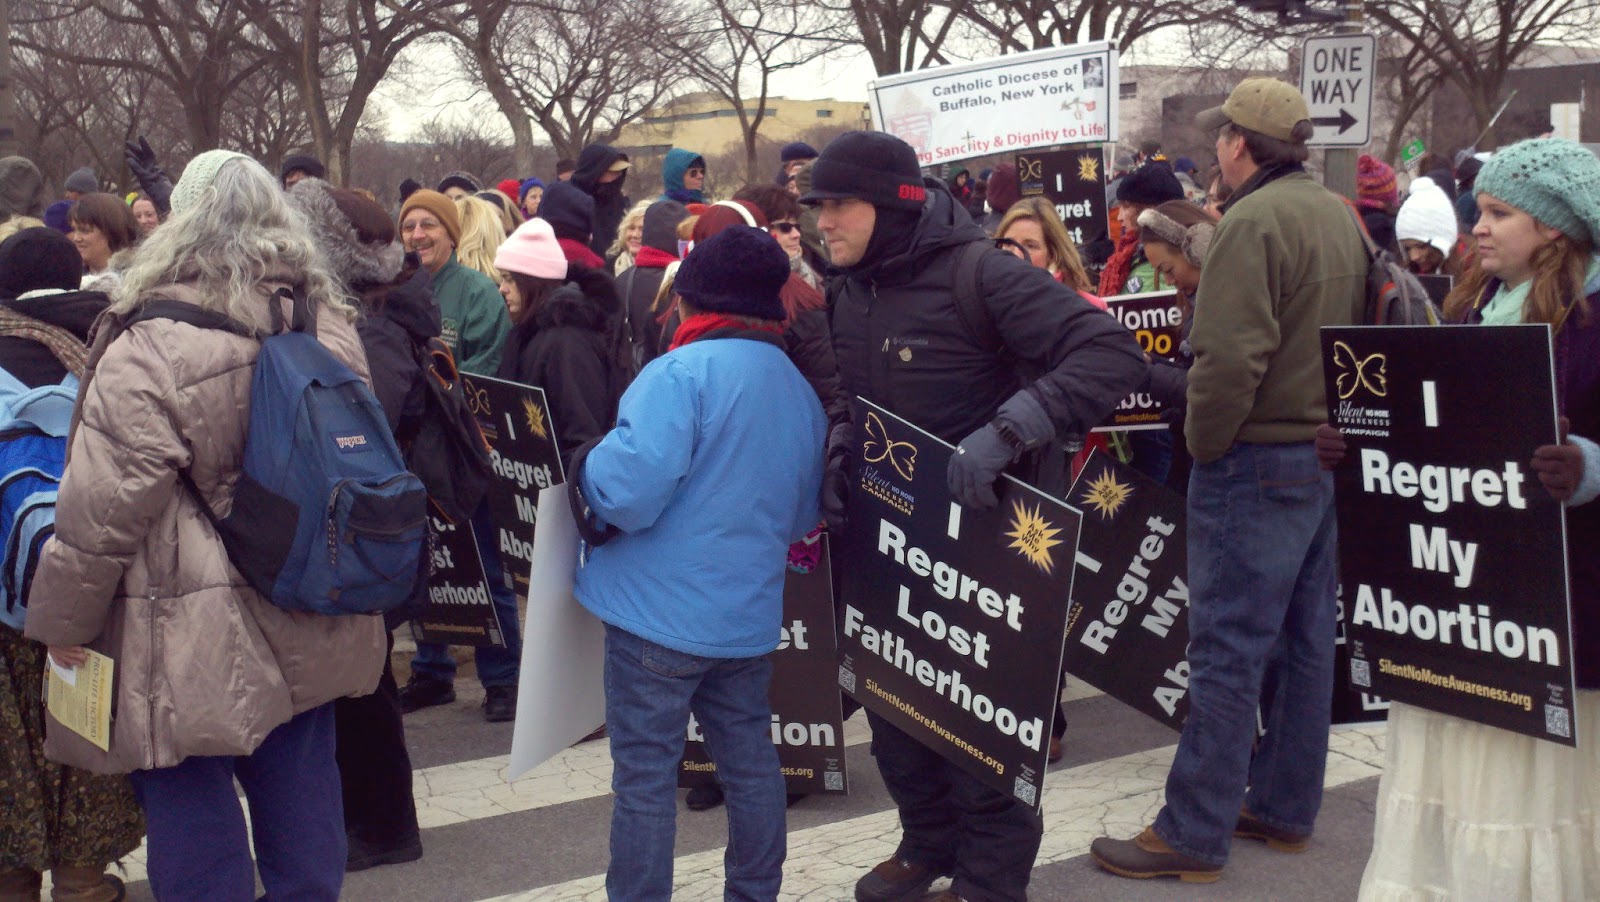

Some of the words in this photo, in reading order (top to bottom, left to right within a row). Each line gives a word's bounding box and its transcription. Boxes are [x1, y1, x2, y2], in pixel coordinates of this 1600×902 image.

[1313, 47, 1362, 73] ONE
[932, 78, 993, 97] Catholic
[998, 68, 1058, 86] Diocese
[1063, 64, 1078, 76] of
[1311, 78, 1362, 104] WAY
[940, 95, 996, 112] Buffalo,
[1001, 88, 1034, 102] New
[1040, 82, 1074, 96] York
[993, 136, 1003, 148] &
[1007, 129, 1058, 146] Dignity
[1062, 127, 1077, 138] to
[1081, 123, 1106, 137] Life!
[1056, 173, 1063, 192] I
[1056, 199, 1092, 221] gret
[1136, 330, 1172, 354] Do
[1333, 401, 1364, 417] Silent
[1422, 380, 1439, 427] I
[504, 412, 516, 441] I
[1337, 416, 1390, 426] AWARENESS
[1339, 428, 1390, 437] CAMPAIGN
[860, 466, 891, 489] Silent
[1361, 448, 1527, 513] Regret
[862, 477, 914, 511] AWARENESS
[862, 484, 912, 516] CAMPAIGN
[947, 501, 962, 540] I
[434, 545, 454, 569] st
[1075, 550, 1102, 574] I
[1409, 523, 1479, 588] My
[878, 518, 1025, 631] Regret
[1079, 515, 1176, 655] Regret
[429, 581, 489, 605] erhood
[1140, 575, 1190, 639] My
[897, 584, 991, 669] Lost
[1352, 583, 1561, 667] Abortion
[844, 603, 1043, 752] Fatherhood
[1378, 657, 1532, 711] SilentNoMoreAwareness.org
[865, 678, 1005, 775] SilentNoMoreAwareness.org
